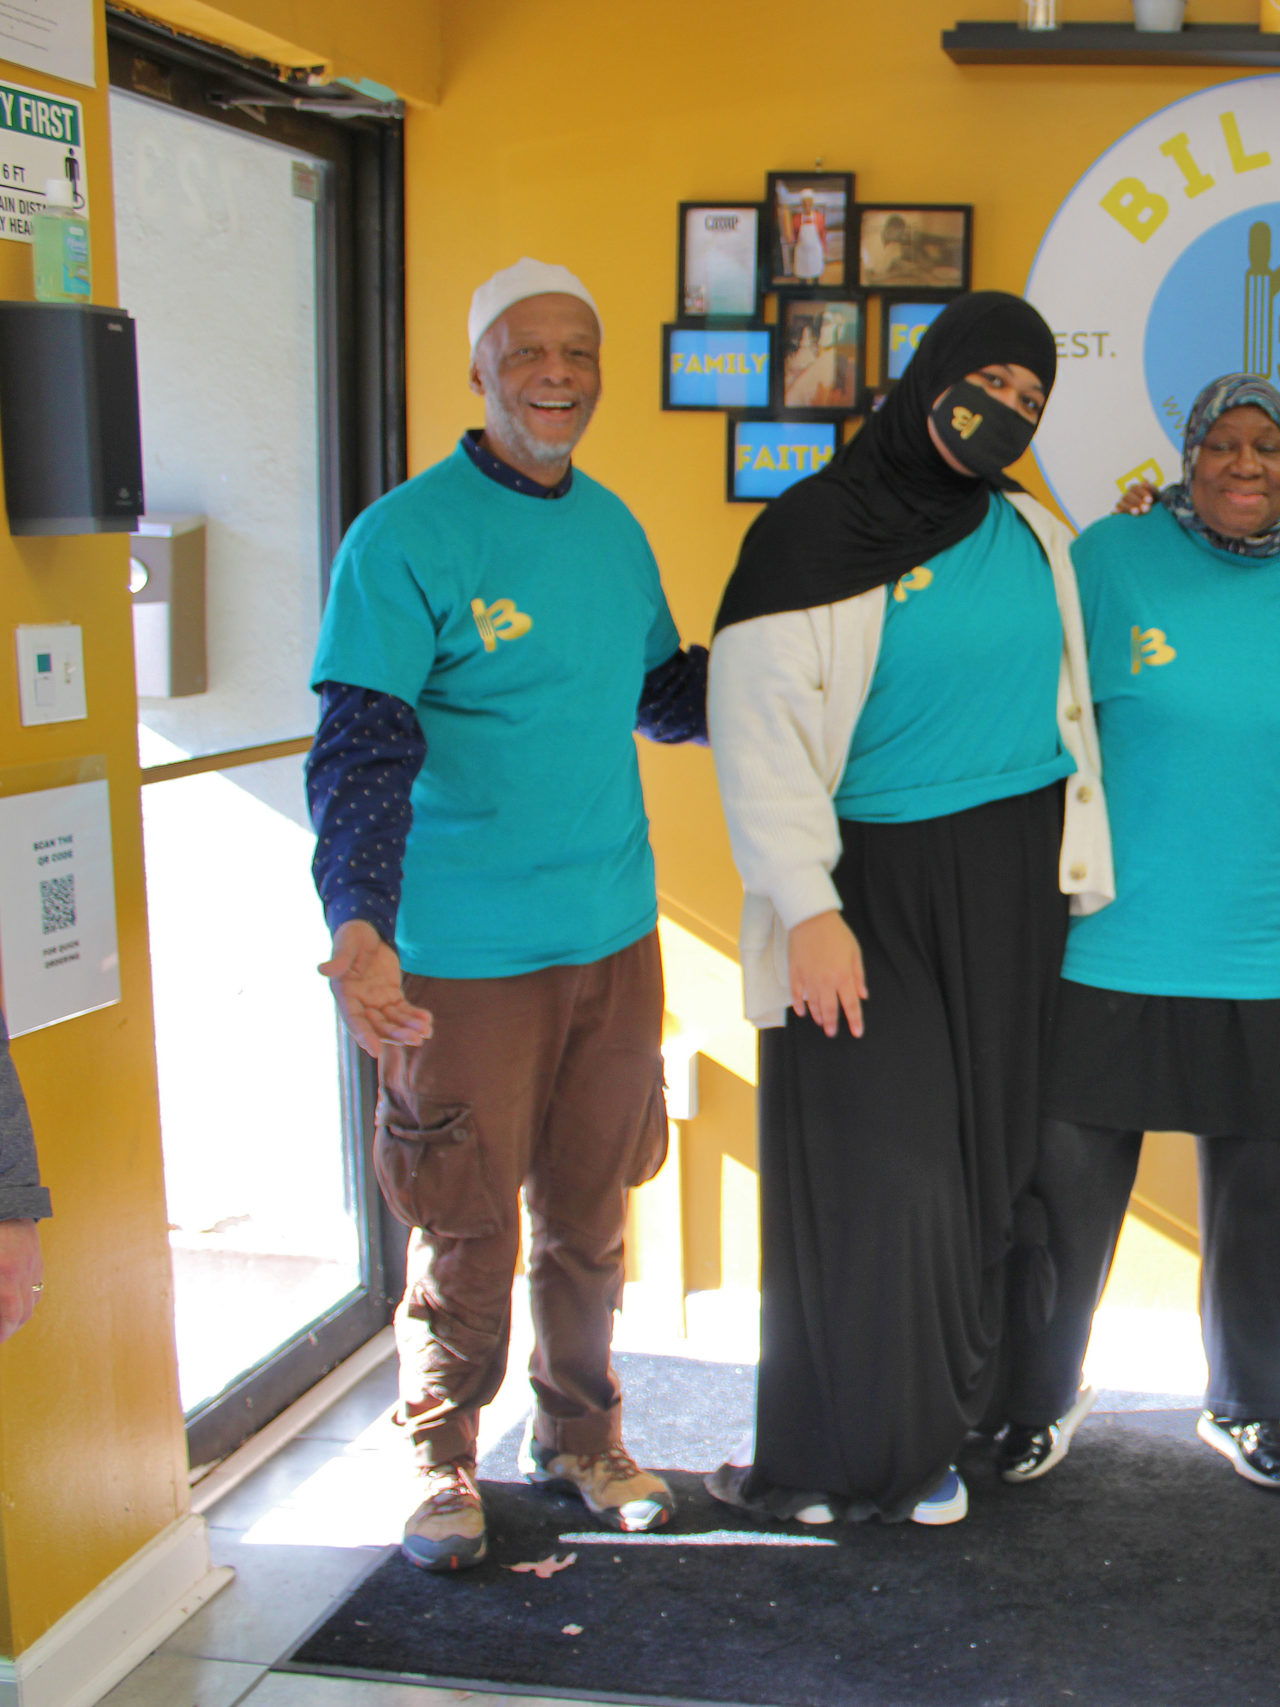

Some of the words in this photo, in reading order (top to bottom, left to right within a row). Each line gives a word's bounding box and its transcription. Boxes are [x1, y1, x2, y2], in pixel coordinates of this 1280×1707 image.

[19, 96, 74, 141] FIRST
[3, 163, 10, 180] 6
[13, 165, 26, 183] FT
[1053, 332, 1116, 359] EST.
[672, 353, 769, 374] FAMILY
[736, 445, 834, 471] FAITH
